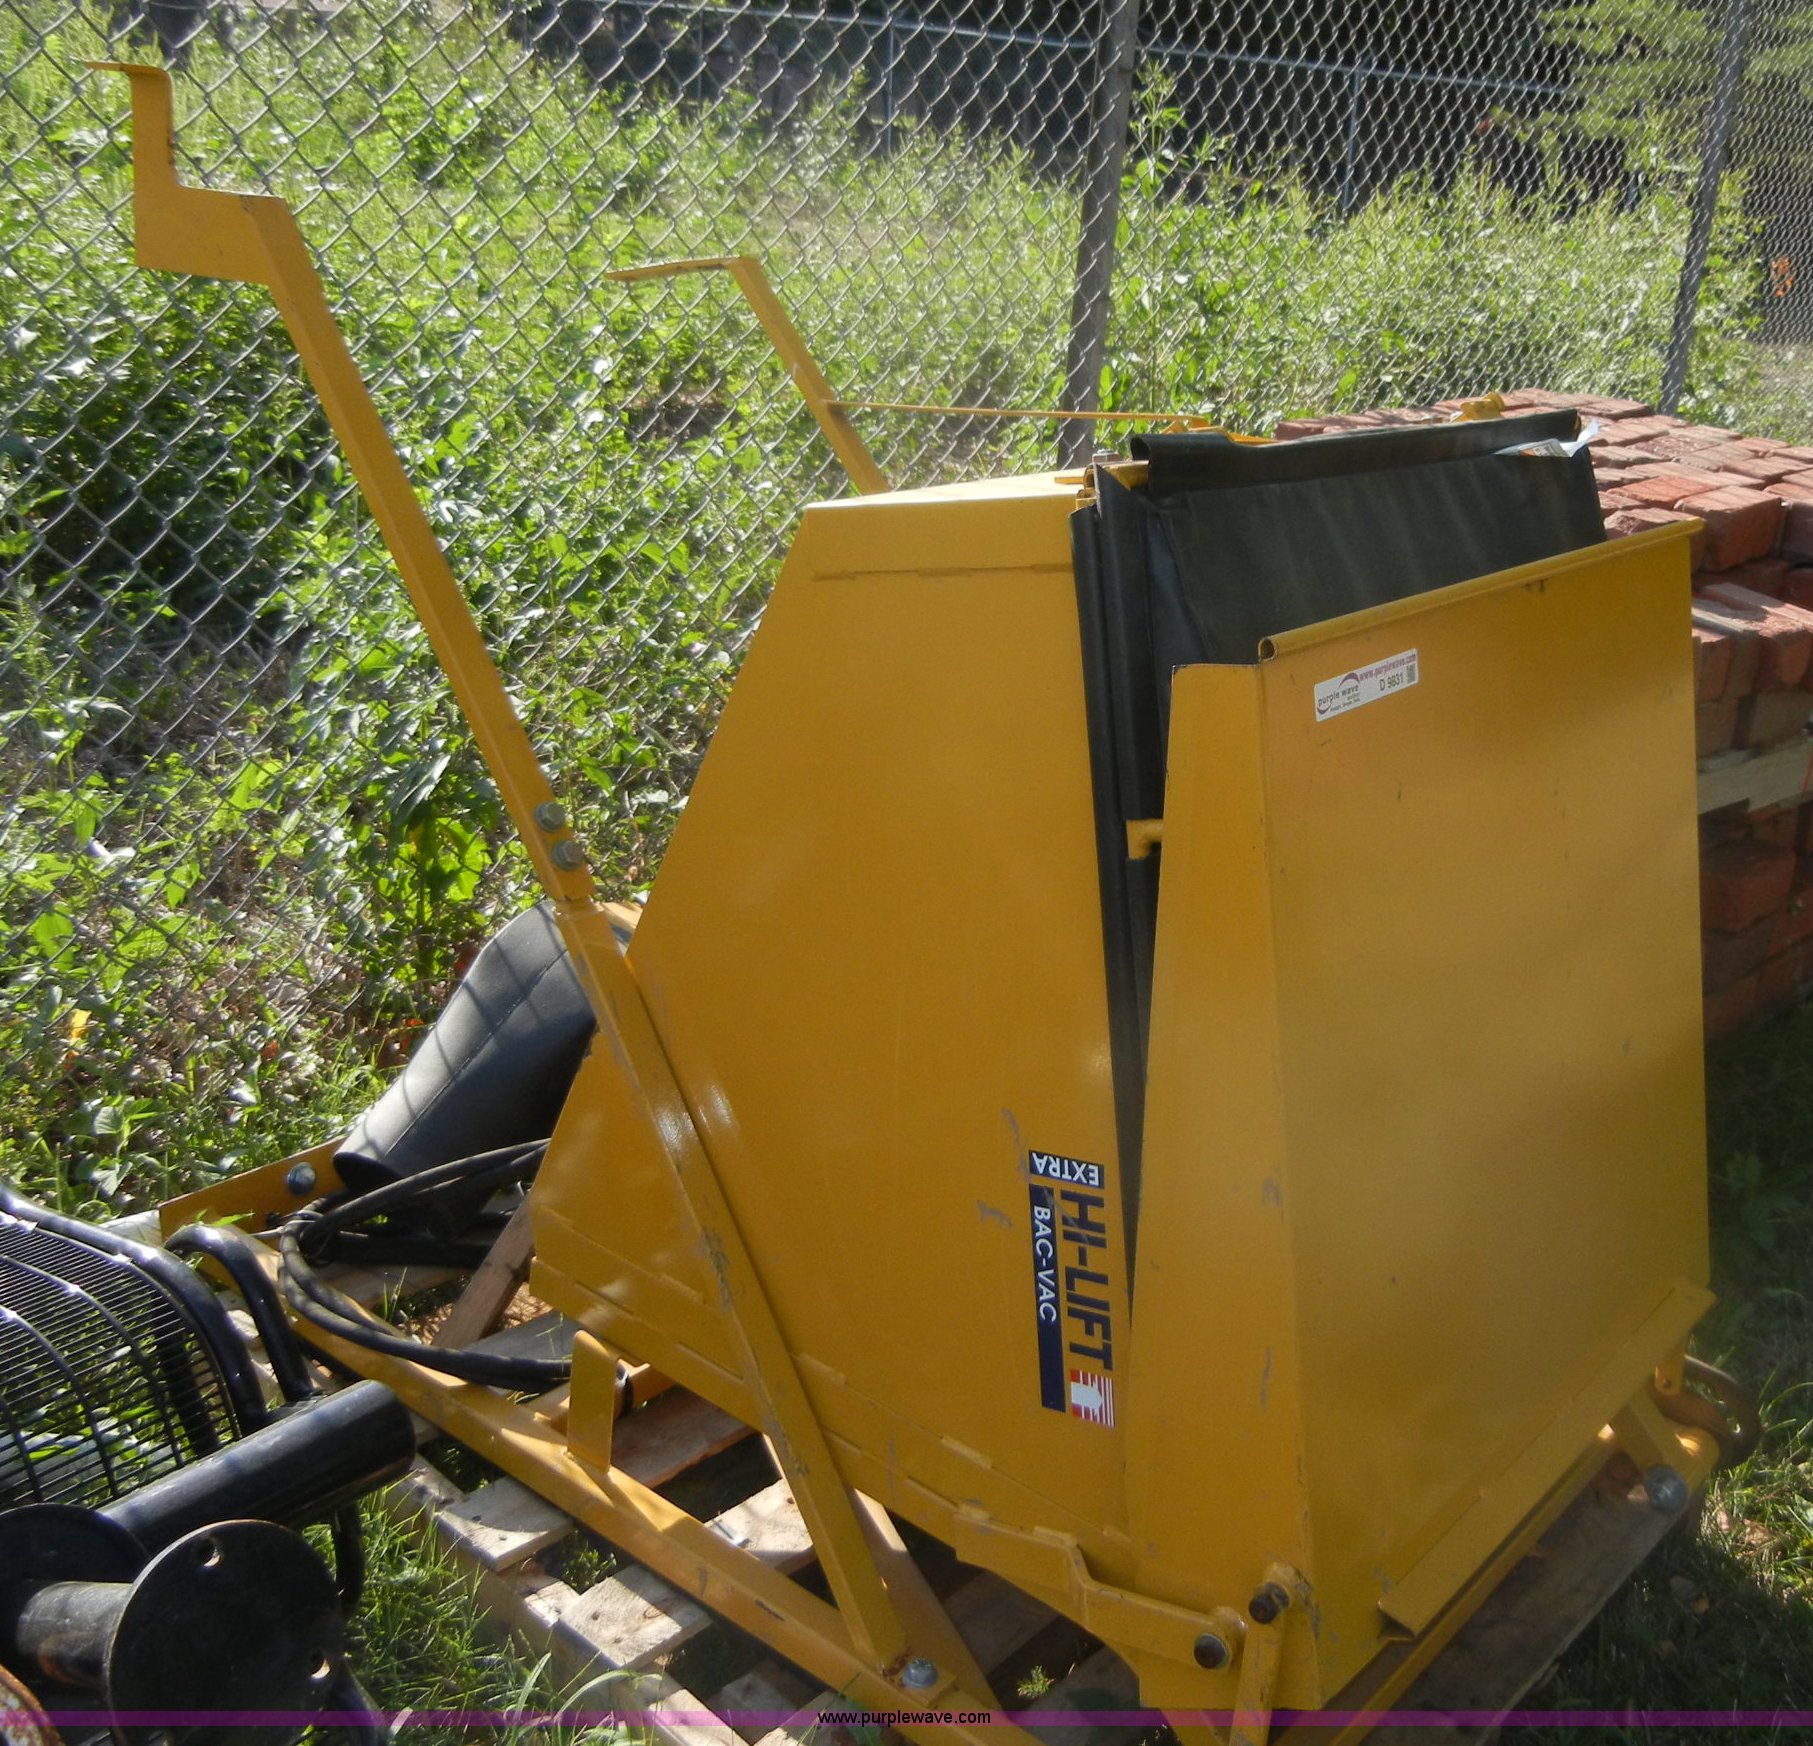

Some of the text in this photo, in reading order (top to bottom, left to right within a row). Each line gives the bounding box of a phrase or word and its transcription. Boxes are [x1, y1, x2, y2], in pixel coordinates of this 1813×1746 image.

[1318, 691, 1340, 707] purple
[1341, 684, 1359, 696] wave
[1380, 679, 1386, 691] D
[1032, 1152, 1100, 1186] EXTRA
[1033, 1205, 1057, 1322] BAC-VAC
[1061, 1189, 1113, 1371] HI-LIFT
